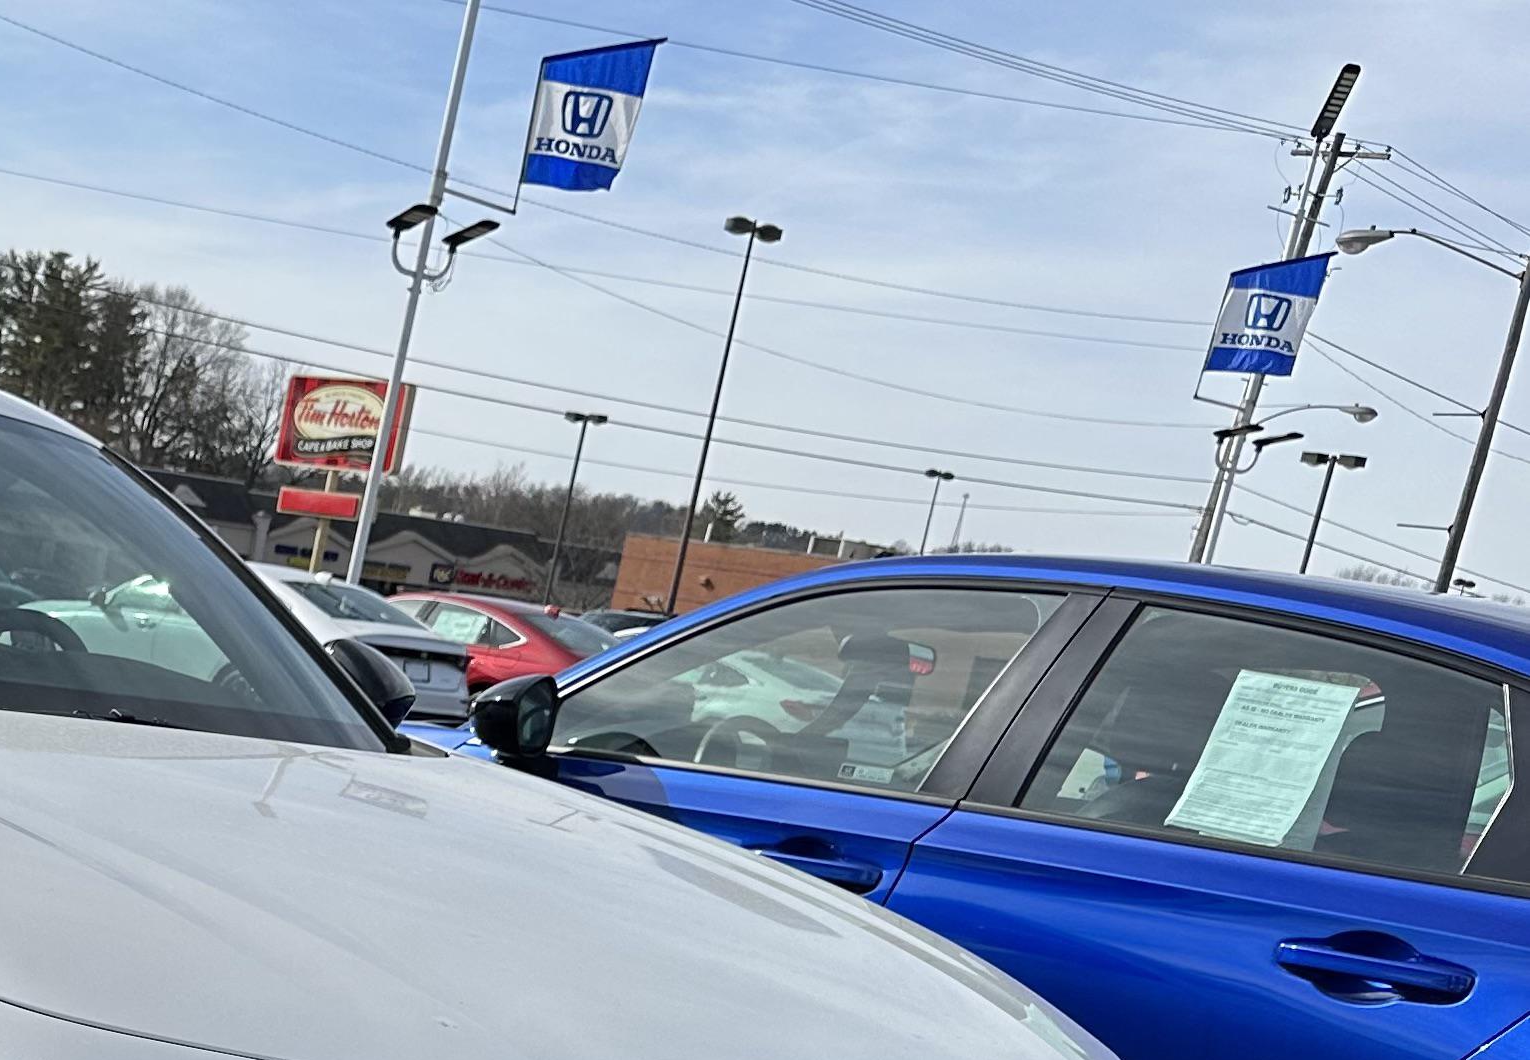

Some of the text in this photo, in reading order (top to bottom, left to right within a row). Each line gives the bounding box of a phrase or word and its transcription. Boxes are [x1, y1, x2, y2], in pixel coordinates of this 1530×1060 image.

[534, 137, 618, 164] HONDA
[1220, 333, 1295, 353] HONDA
[298, 397, 381, 430] Tim Horton
[350, 438, 374, 449] SHOP
